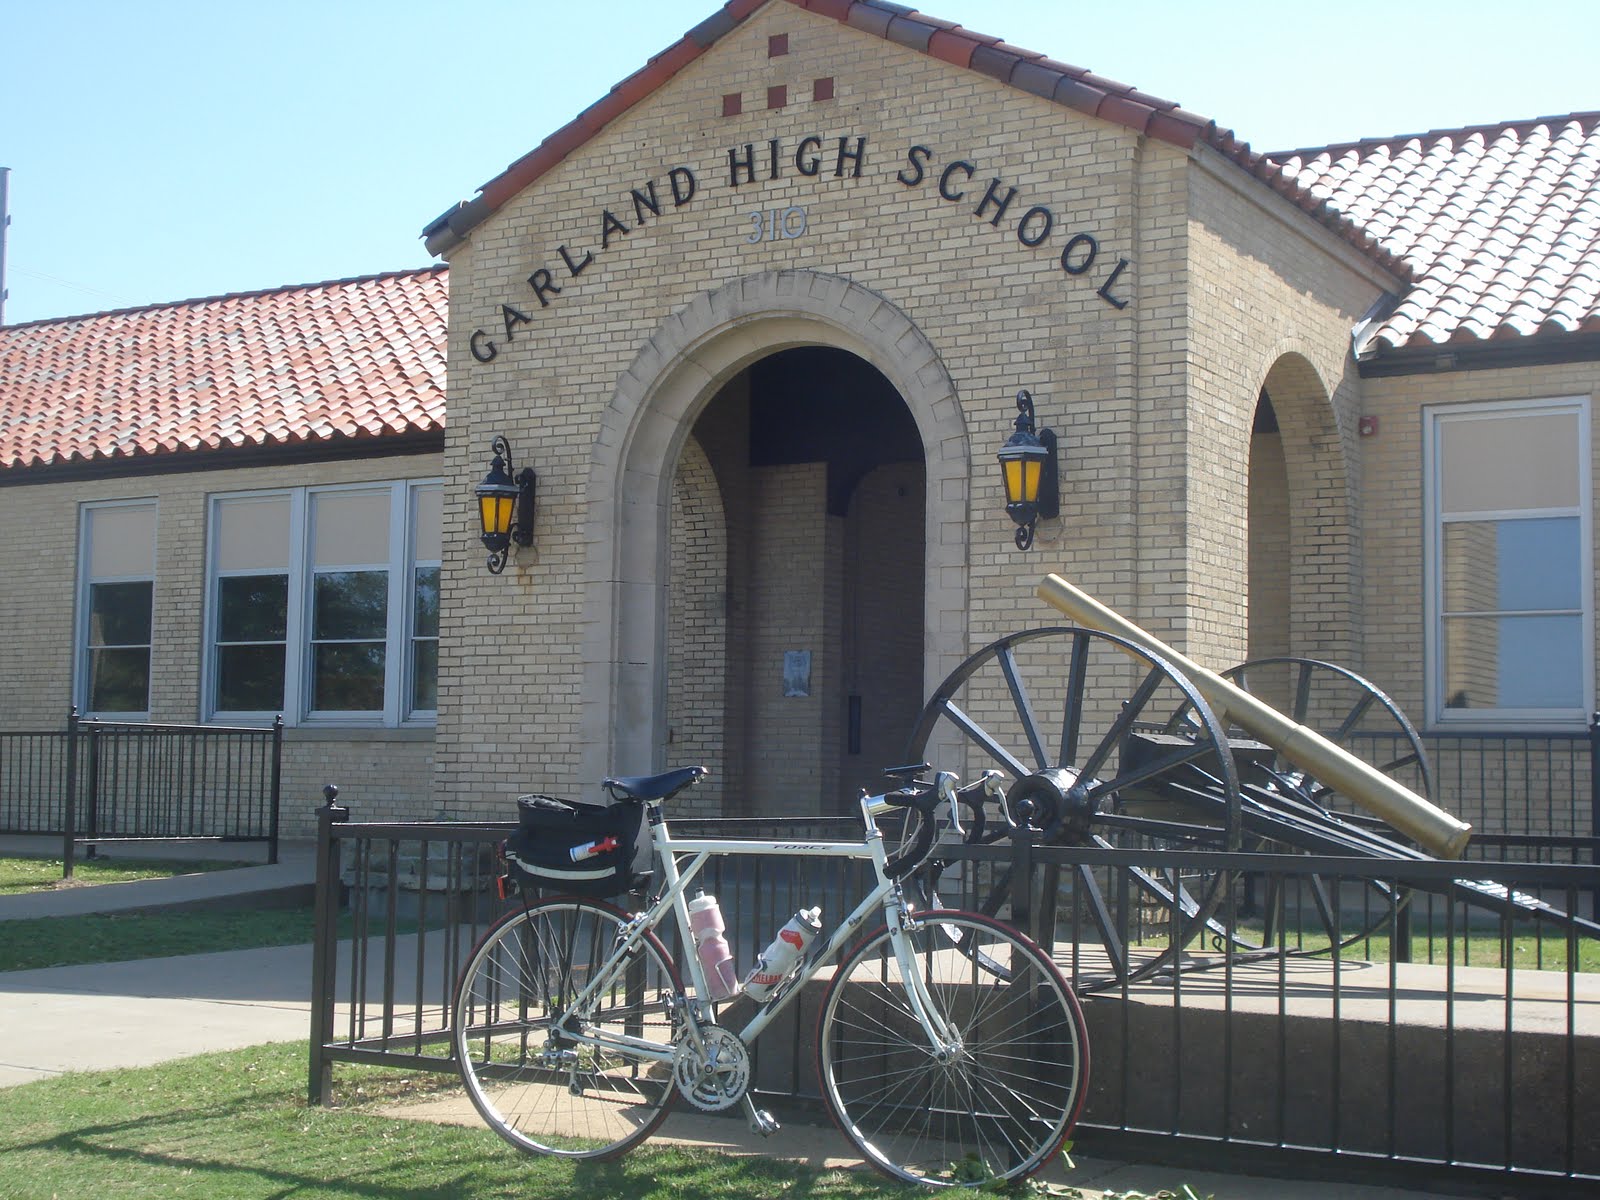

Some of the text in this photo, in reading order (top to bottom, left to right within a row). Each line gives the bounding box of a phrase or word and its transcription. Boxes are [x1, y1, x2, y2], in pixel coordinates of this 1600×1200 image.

[470, 136, 1129, 362] GARLAND HIGH SCHOOL
[746, 206, 806, 244] 310
